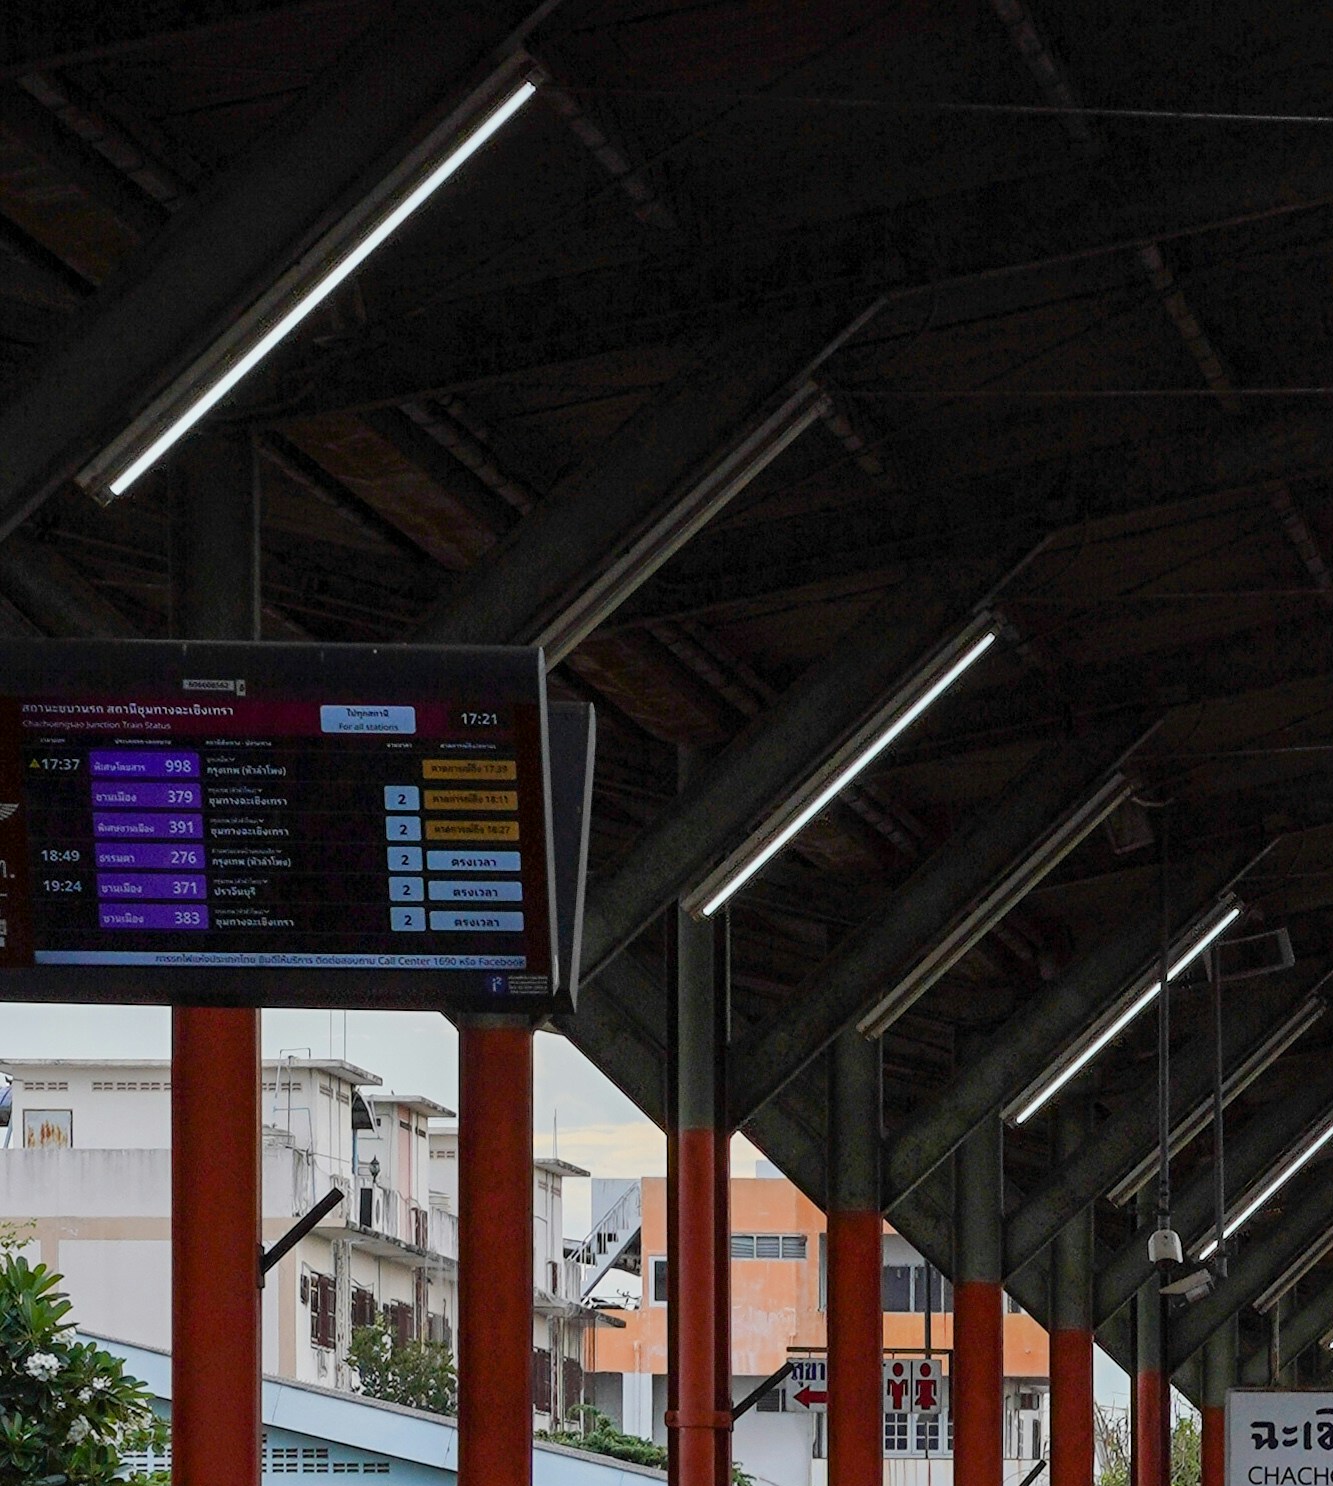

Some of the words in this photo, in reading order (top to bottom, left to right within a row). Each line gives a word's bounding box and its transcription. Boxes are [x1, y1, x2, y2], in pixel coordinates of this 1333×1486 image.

[107, 702, 234, 718] สถานีชุมทางฉะเชิงเทรา
[460, 713, 498, 725] 17:21
[86, 721, 120, 730] Junction
[122, 721, 143, 729] Train
[145, 721, 171, 730] Status
[339, 723, 352, 731] For
[354, 723, 364, 731] all
[366, 723, 399, 731] stations
[41, 758, 80, 770] 17:37
[165, 760, 192, 773] 998
[168, 790, 193, 803] 379
[398, 794, 406, 805] 2
[169, 821, 194, 834] 391
[400, 824, 408, 835] 2
[41, 850, 80, 862] 18:49
[99, 854, 135, 863] ธรรมดา
[171, 851, 197, 864] 276
[401, 855, 409, 865] 2
[451, 859, 497, 867] ตรงเวลา
[43, 880, 83, 892] 19:24
[173, 881, 198, 894] 371
[402, 885, 411, 896] 2
[453, 889, 498, 897] ตรงเวลา
[174, 911, 200, 925] 383
[404, 915, 412, 926] 2
[454, 919, 500, 927] ตรงเวลา
[378, 956, 395, 966] Call
[398, 956, 430, 966] Center
[434, 956, 456, 966] 1690
[479, 957, 525, 967] Facebook
